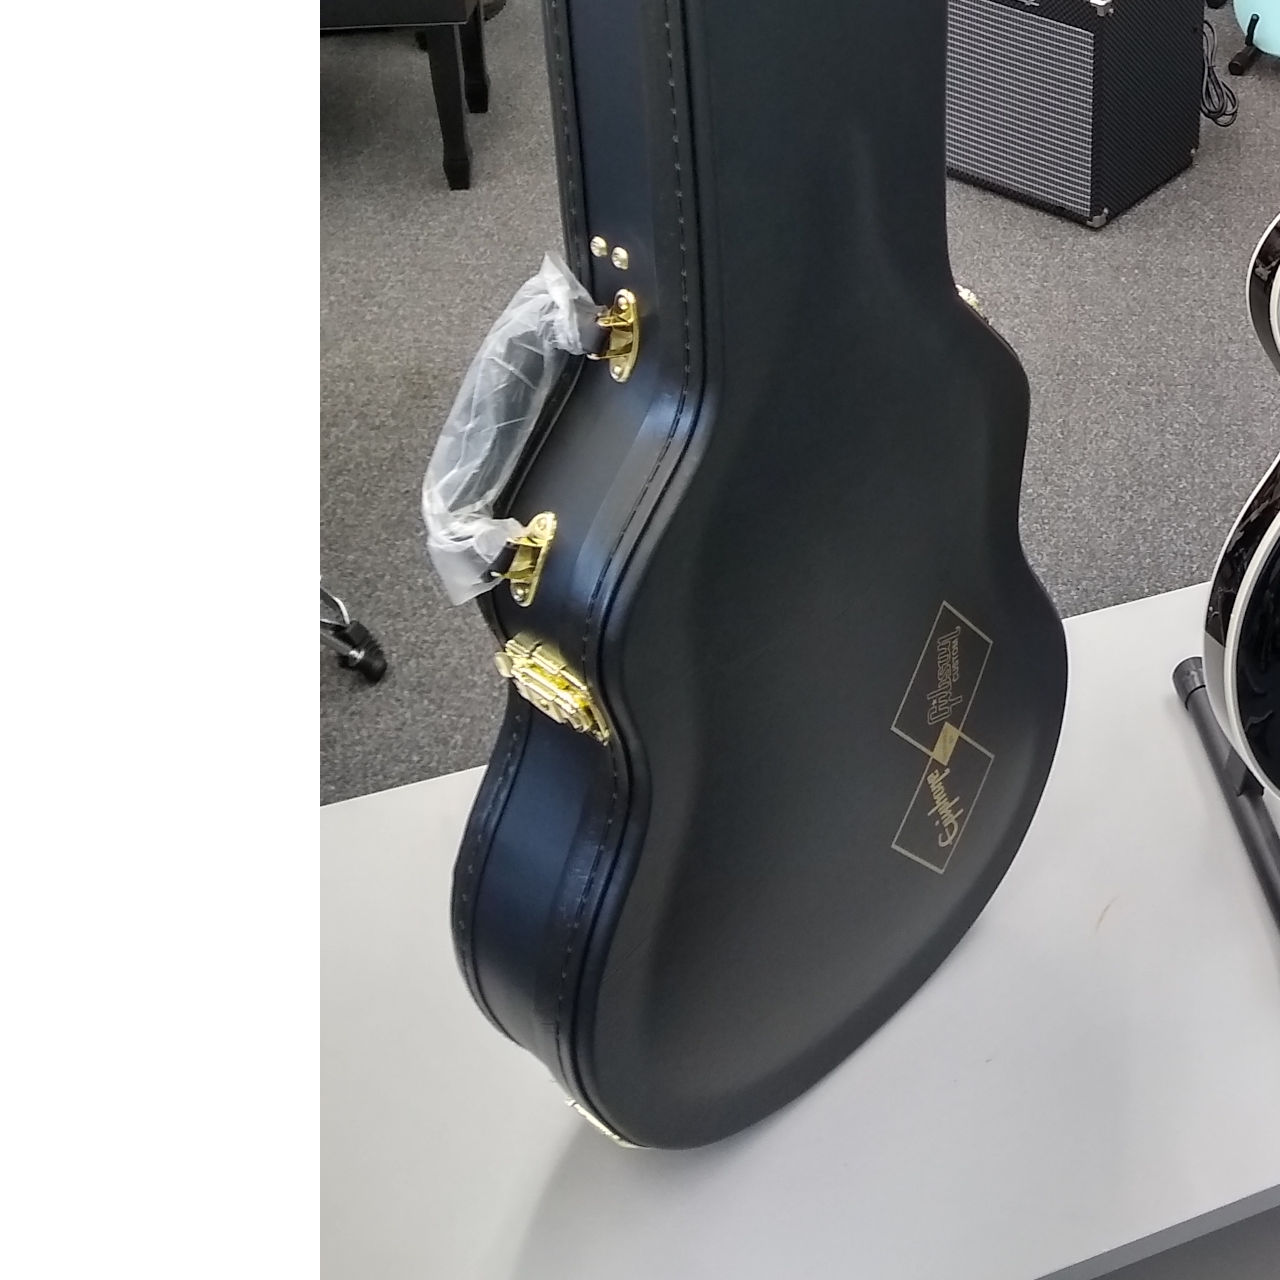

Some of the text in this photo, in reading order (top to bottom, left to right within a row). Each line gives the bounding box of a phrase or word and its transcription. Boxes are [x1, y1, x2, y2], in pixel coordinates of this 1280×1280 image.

[926, 625, 964, 725] Gibson
[949, 638, 959, 683] CUSTOM
[926, 768, 964, 848] Epiphone
